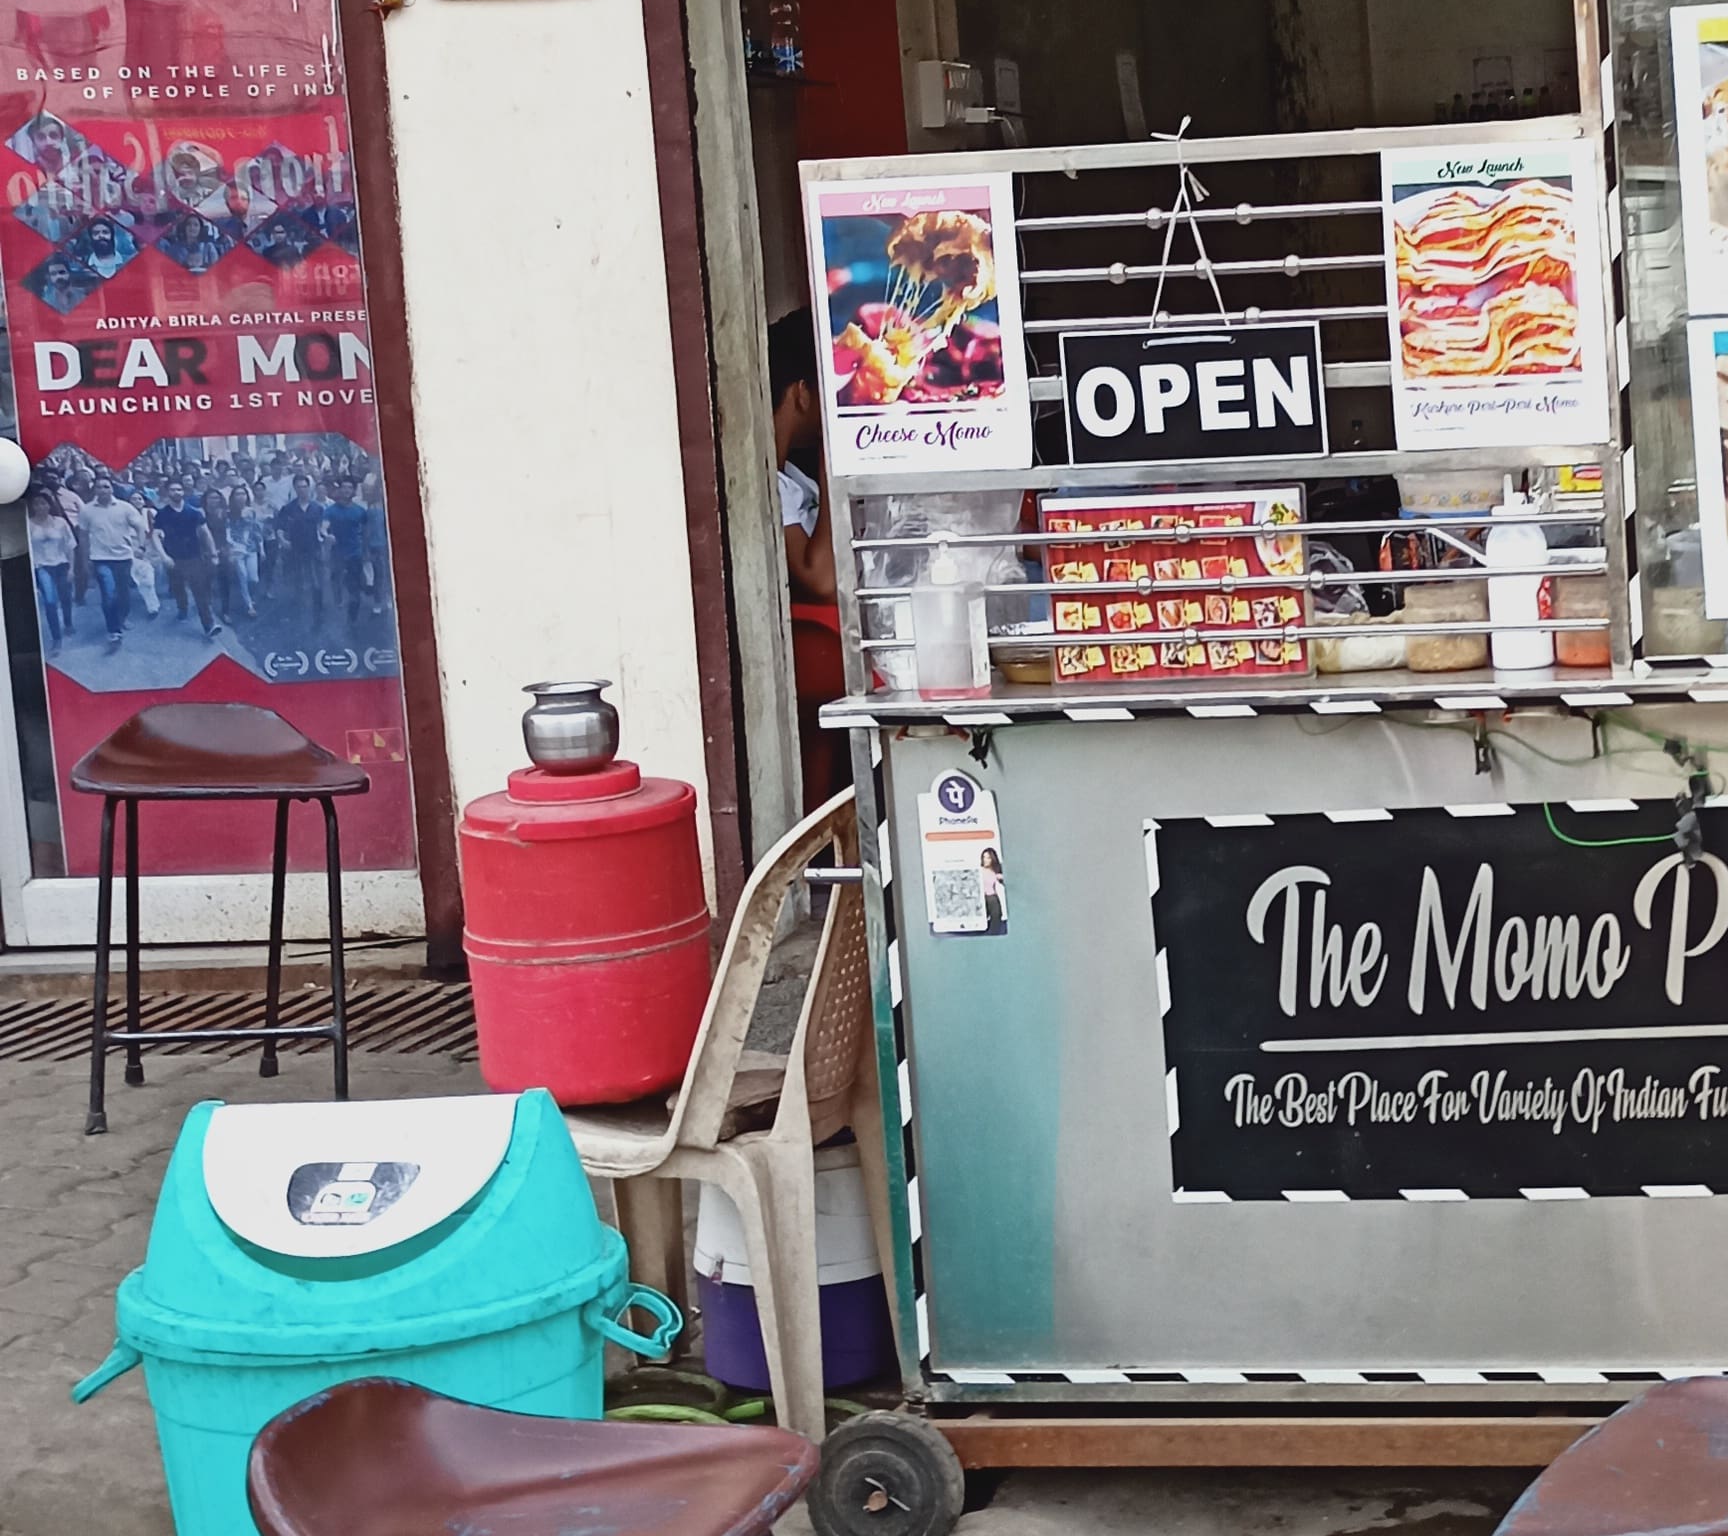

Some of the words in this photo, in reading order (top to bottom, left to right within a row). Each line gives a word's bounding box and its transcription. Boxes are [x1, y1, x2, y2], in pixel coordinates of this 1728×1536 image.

[17, 67, 100, 81] BASED
[119, 65, 151, 80] ON
[167, 64, 216, 79] THE
[233, 63, 288, 78] LIFE
[84, 86, 114, 100] OF
[132, 84, 230, 99] PEOPLE
[248, 83, 277, 97] OF
[1438, 161, 1473, 179] New
[1477, 157, 1525, 177] Launch
[96, 317, 161, 330] ADITYA
[169, 314, 222, 328] BIRLA
[230, 311, 304, 326] CAPITAL
[33, 336, 209, 392] DEAR
[40, 394, 213, 416] LAUNCHING
[230, 391, 283, 409] 1ST
[1075, 355, 1314, 438] OPEN
[856, 423, 919, 451] Cheese
[924, 420, 993, 451] Momo
[1246, 865, 1389, 1018] The
[1407, 862, 1632, 1015] Momo
[1225, 1071, 1275, 1127] The
[1274, 1072, 1338, 1127] Best
[1338, 1071, 1419, 1126] Place
[1417, 1070, 1471, 1124] For
[1470, 1069, 1568, 1135] Variety
[1571, 1067, 1607, 1133] Of
[1606, 1068, 1688, 1122] Indian
